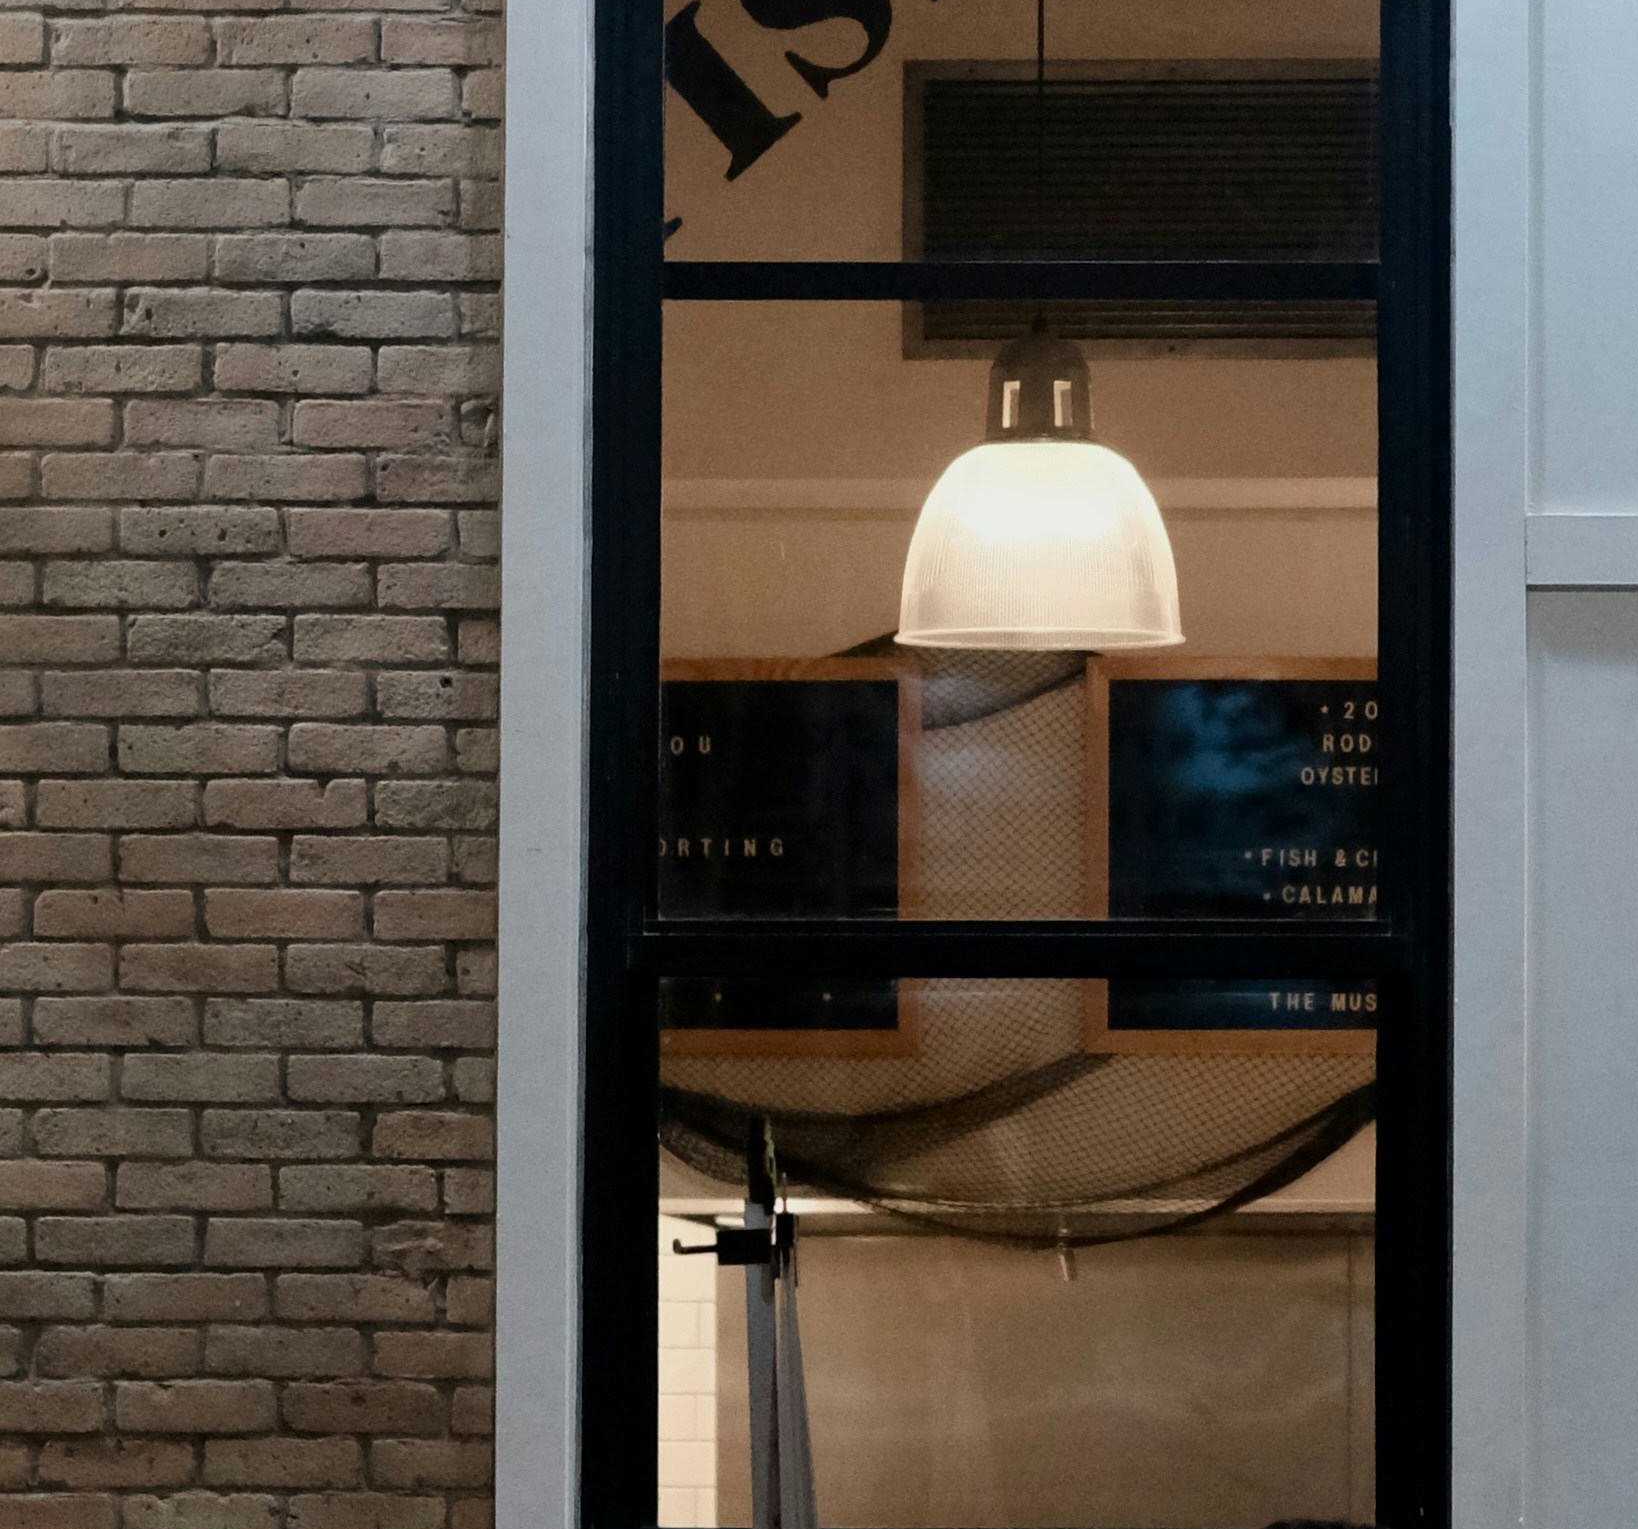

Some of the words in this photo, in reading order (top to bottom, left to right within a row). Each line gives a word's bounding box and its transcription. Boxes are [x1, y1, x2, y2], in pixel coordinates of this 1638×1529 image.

[1321, 733, 1372, 753] ROD
[1300, 765, 1378, 786] OYSTE
[1260, 847, 1318, 867] FISH
[1333, 848, 1347, 868] &
[1267, 991, 1316, 1011] THE
[1330, 992, 1378, 1012] MUS
